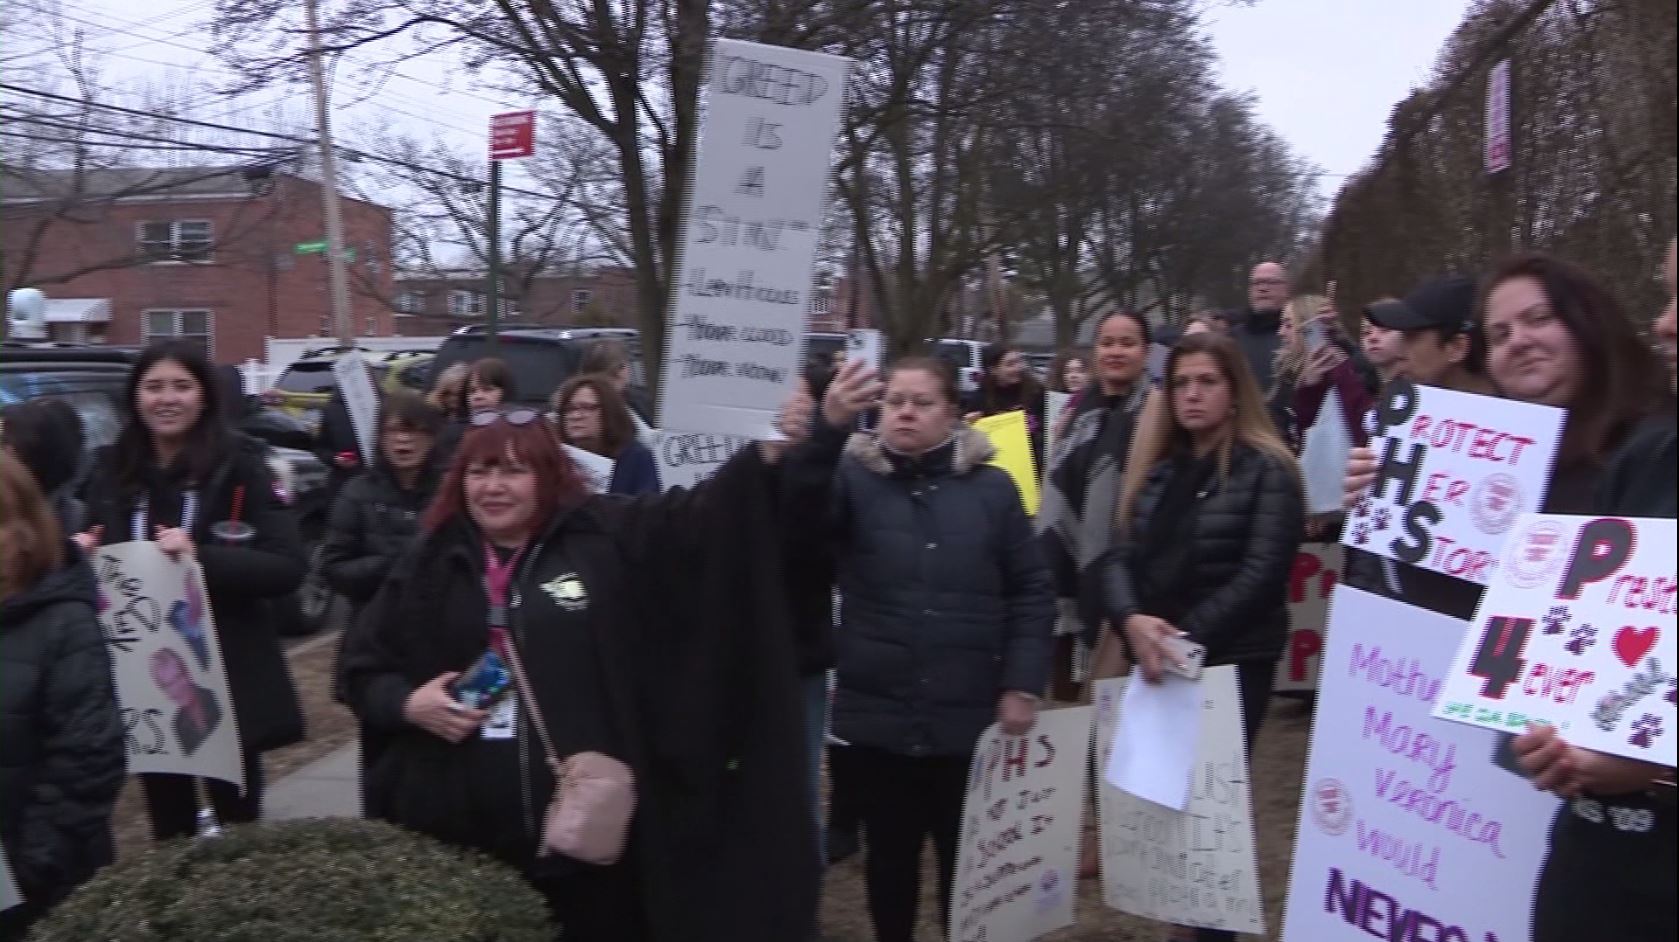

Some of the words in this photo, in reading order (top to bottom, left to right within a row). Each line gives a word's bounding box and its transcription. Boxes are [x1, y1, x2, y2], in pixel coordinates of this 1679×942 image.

[740, 117, 784, 150] IS
[1389, 501, 1502, 584] STOR
[1555, 517, 1677, 617] Prest
[1361, 706, 1458, 794] Mary
[1356, 820, 1442, 892] would
